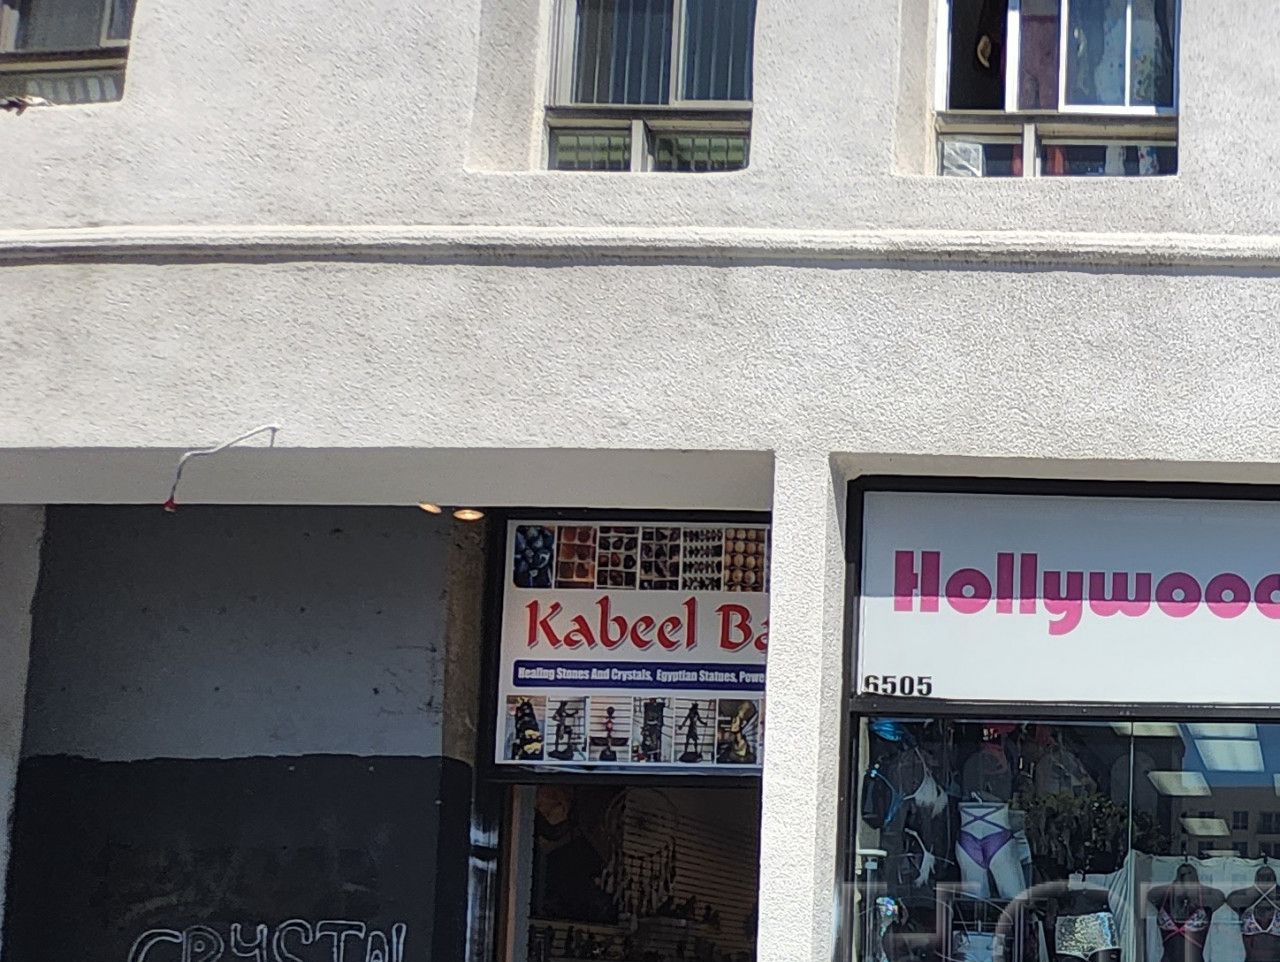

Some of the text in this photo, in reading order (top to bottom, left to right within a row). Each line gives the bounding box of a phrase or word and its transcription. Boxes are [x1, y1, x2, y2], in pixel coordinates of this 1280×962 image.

[525, 595, 697, 650] Kabeel
[518, 666, 554, 681] Healing
[556, 667, 589, 679] Stones
[591, 667, 610, 680] And
[656, 668, 697, 683] Egyptian
[863, 674, 933, 696] 6505
